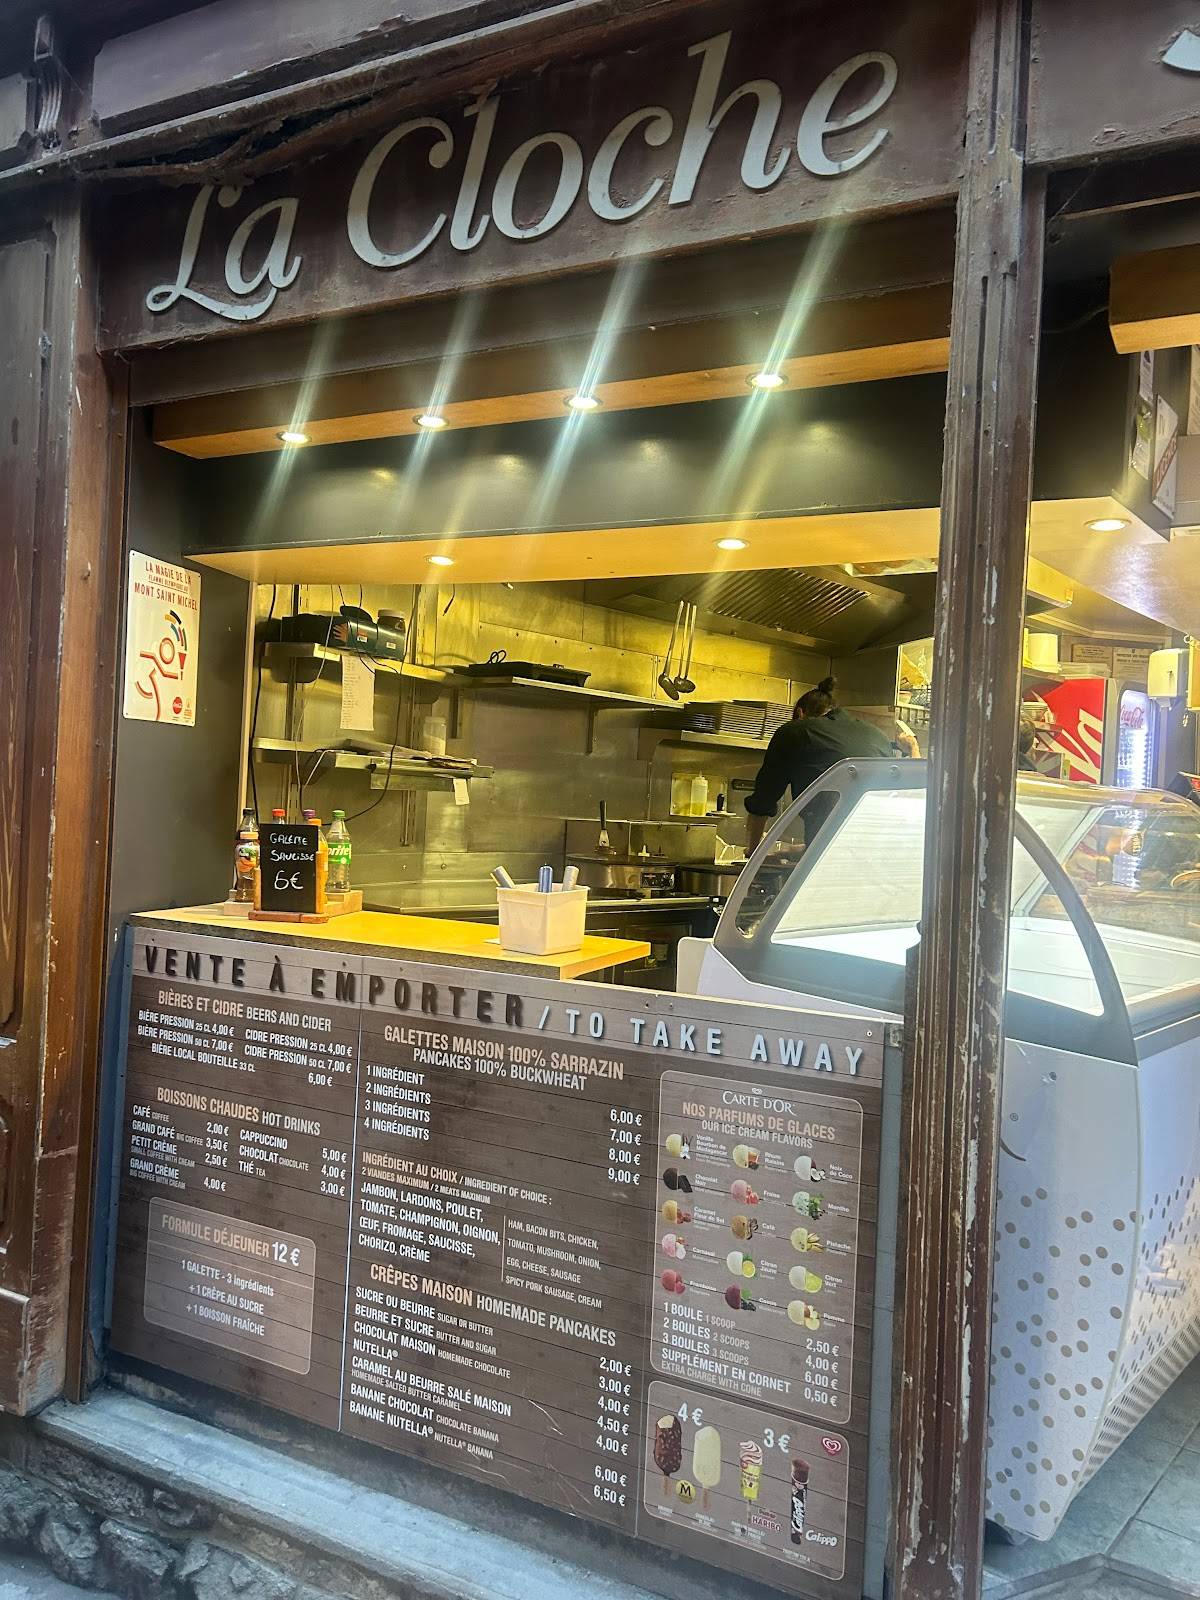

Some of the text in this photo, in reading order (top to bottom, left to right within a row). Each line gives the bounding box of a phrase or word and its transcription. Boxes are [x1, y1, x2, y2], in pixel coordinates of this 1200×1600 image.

[146, 30, 899, 322] La Cloche
[146, 561, 191, 585] LA MAGIE DE LA
[134, 582, 197, 610] MONT SAINT MICHEL
[145, 944, 863, 1076] VENTE À EMPORTER / TO TAKE AWAY
[158, 989, 331, 1032] BIÈRES ET CIDRE BEERS AND CIDER
[245, 1029, 268, 1042] CIDRE
[270, 1033, 308, 1049] PRESSION
[310, 1042, 318, 1051] 25
[384, 1024, 624, 1080] GALETTES MAISON 100% SARRAZIN
[151, 1042, 256, 1072] BIÈRE LOCAL BOUTEILLE 33 CL
[413, 1048, 587, 1091] PANCAKES 100% BUCKWHEAT
[366, 1065, 425, 1086] 1 INGRÉDIENT
[365, 1082, 431, 1105] 2 INGRÉDIENTS
[722, 1090, 759, 1108] CARTE
[133, 1105, 150, 1118] CAFÉ
[157, 1087, 320, 1136] BOISSONS CHAUDES HOT DRINKS
[682, 1102, 836, 1140] NOS PARFUMS DE GLACES
[131, 1135, 177, 1155] PETIT CRÈME
[132, 1120, 175, 1139] GRAND CAFÉ
[240, 1129, 288, 1149] CAPPUCCINO
[702, 1119, 813, 1149] OUR ICE CREAM FLAVORS
[130, 1158, 179, 1179] GRAND CRÈME
[239, 1145, 309, 1171] CHOCOLAT CHOCOLATE
[239, 1161, 266, 1177] THÉ TEA
[362, 1151, 414, 1174] INGRÉDIENT
[415, 1164, 428, 1177] AU
[430, 1166, 458, 1184] CHOIX
[464, 1176, 508, 1196] INGREDIENT
[509, 1186, 519, 1197] OF
[361, 1182, 484, 1223] JAMBON, LARDONS, POULET,
[162, 1214, 210, 1240] FORMULE
[213, 1228, 270, 1258] DÉJEUNER
[360, 1199, 501, 1246] TOMATE, CHAMPIGNON, OIGNON,
[508, 1219, 599, 1250] HAM, BACON BITS, CHICKEN,
[359, 1233, 430, 1262] CHORIZO, CRÈME
[382, 1222, 426, 1245] FROMAGE,
[428, 1233, 475, 1258] SAUCISSE,
[181, 1260, 186, 1270] 1
[187, 1260, 220, 1280] GALETTE
[227, 1272, 232, 1284] 3
[234, 1274, 274, 1296] ingrédients
[202, 1286, 226, 1303] CRÊPE
[227, 1294, 237, 1306] AU
[239, 1298, 264, 1315] SUCRE
[370, 1264, 616, 1347] CRÊPES MAISON HOMEMADE PANCAKES
[199, 1305, 231, 1325] BOISSON
[232, 1316, 265, 1336] FRAÎCHE
[663, 1317, 750, 1350] 2 BOULES 2 SCOOPS
[661, 1347, 792, 1393] SUPPLÉMENT EN CORNET
[352, 1355, 512, 1417] CARAMEL AU BEURRE SALÉ MAISON
[350, 1383, 499, 1443] BANANE CHOCOLAT CHOCOLATE BANANA
[752, 1516, 781, 1532] HARIBO
[805, 1529, 838, 1547] Calippo
